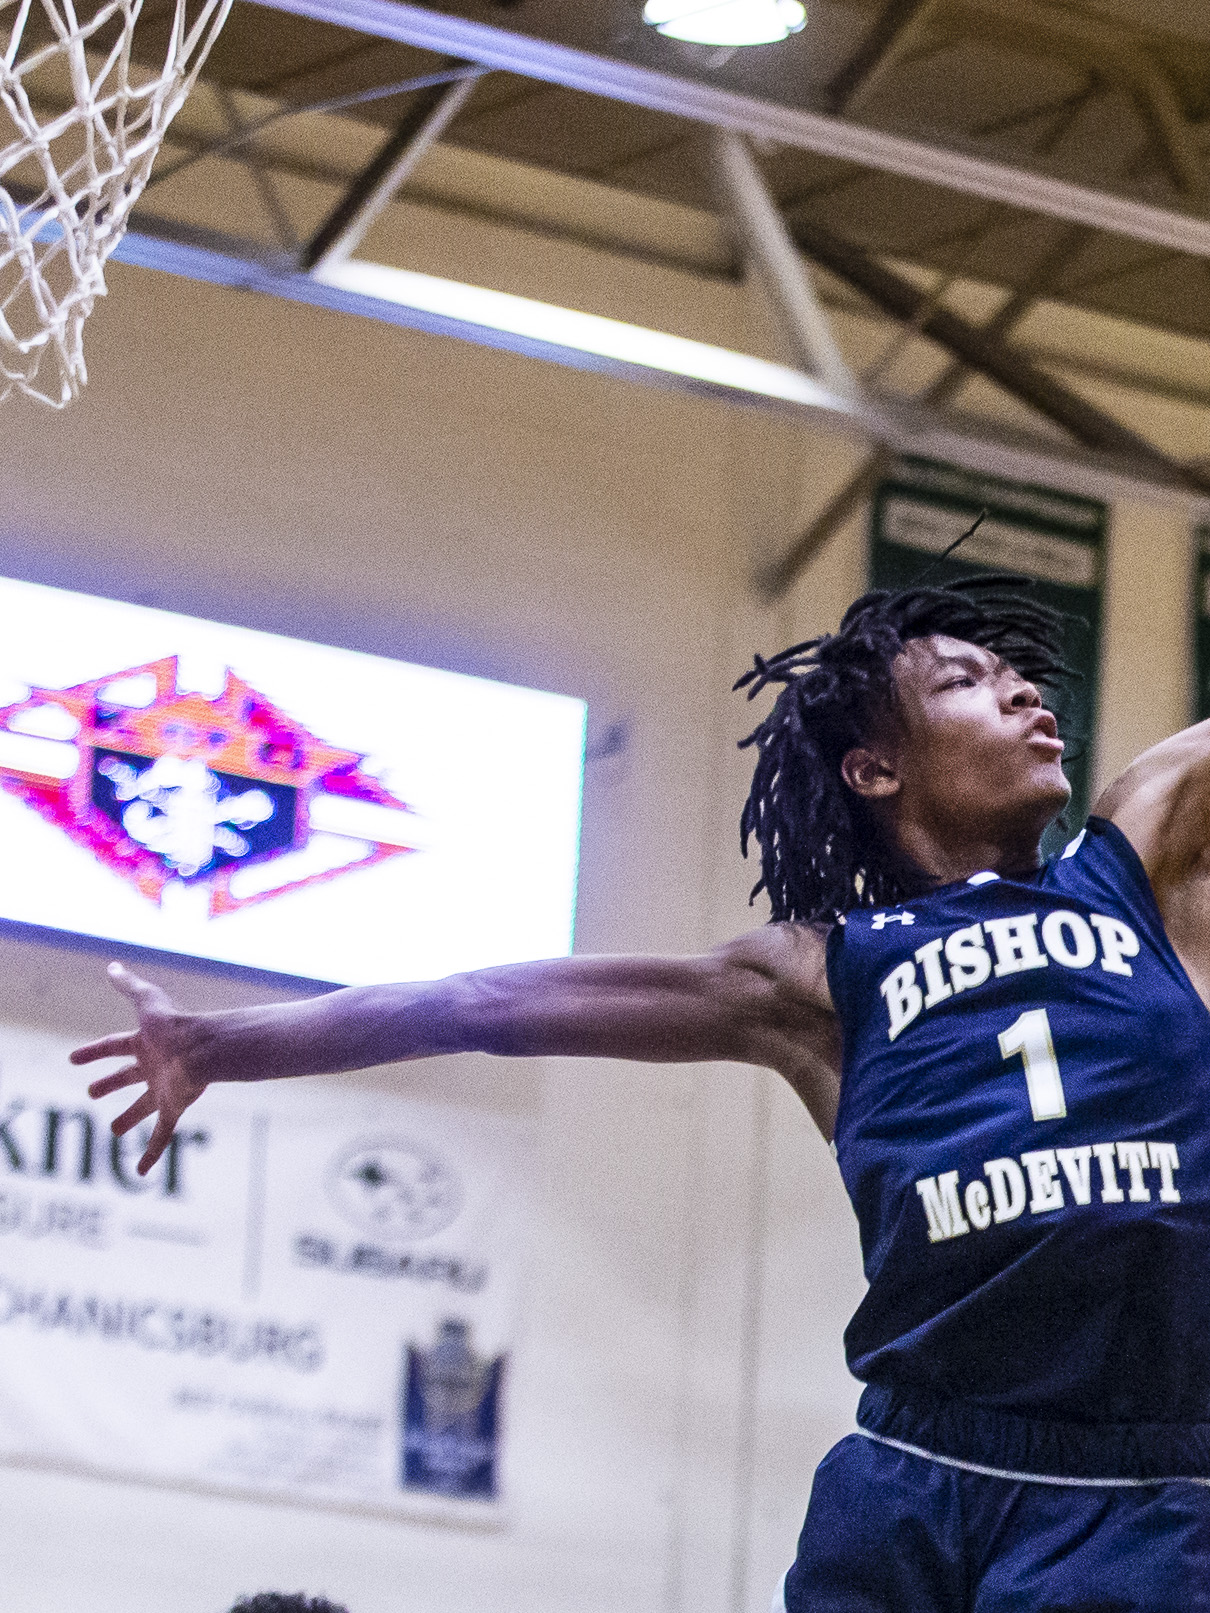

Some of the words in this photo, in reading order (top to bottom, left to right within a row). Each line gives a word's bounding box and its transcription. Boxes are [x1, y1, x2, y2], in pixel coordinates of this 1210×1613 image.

[879, 910, 1140, 1042] BISHOP
[997, 1008, 1067, 1122] 1
[916, 1140, 1181, 1243] McDEVITT
